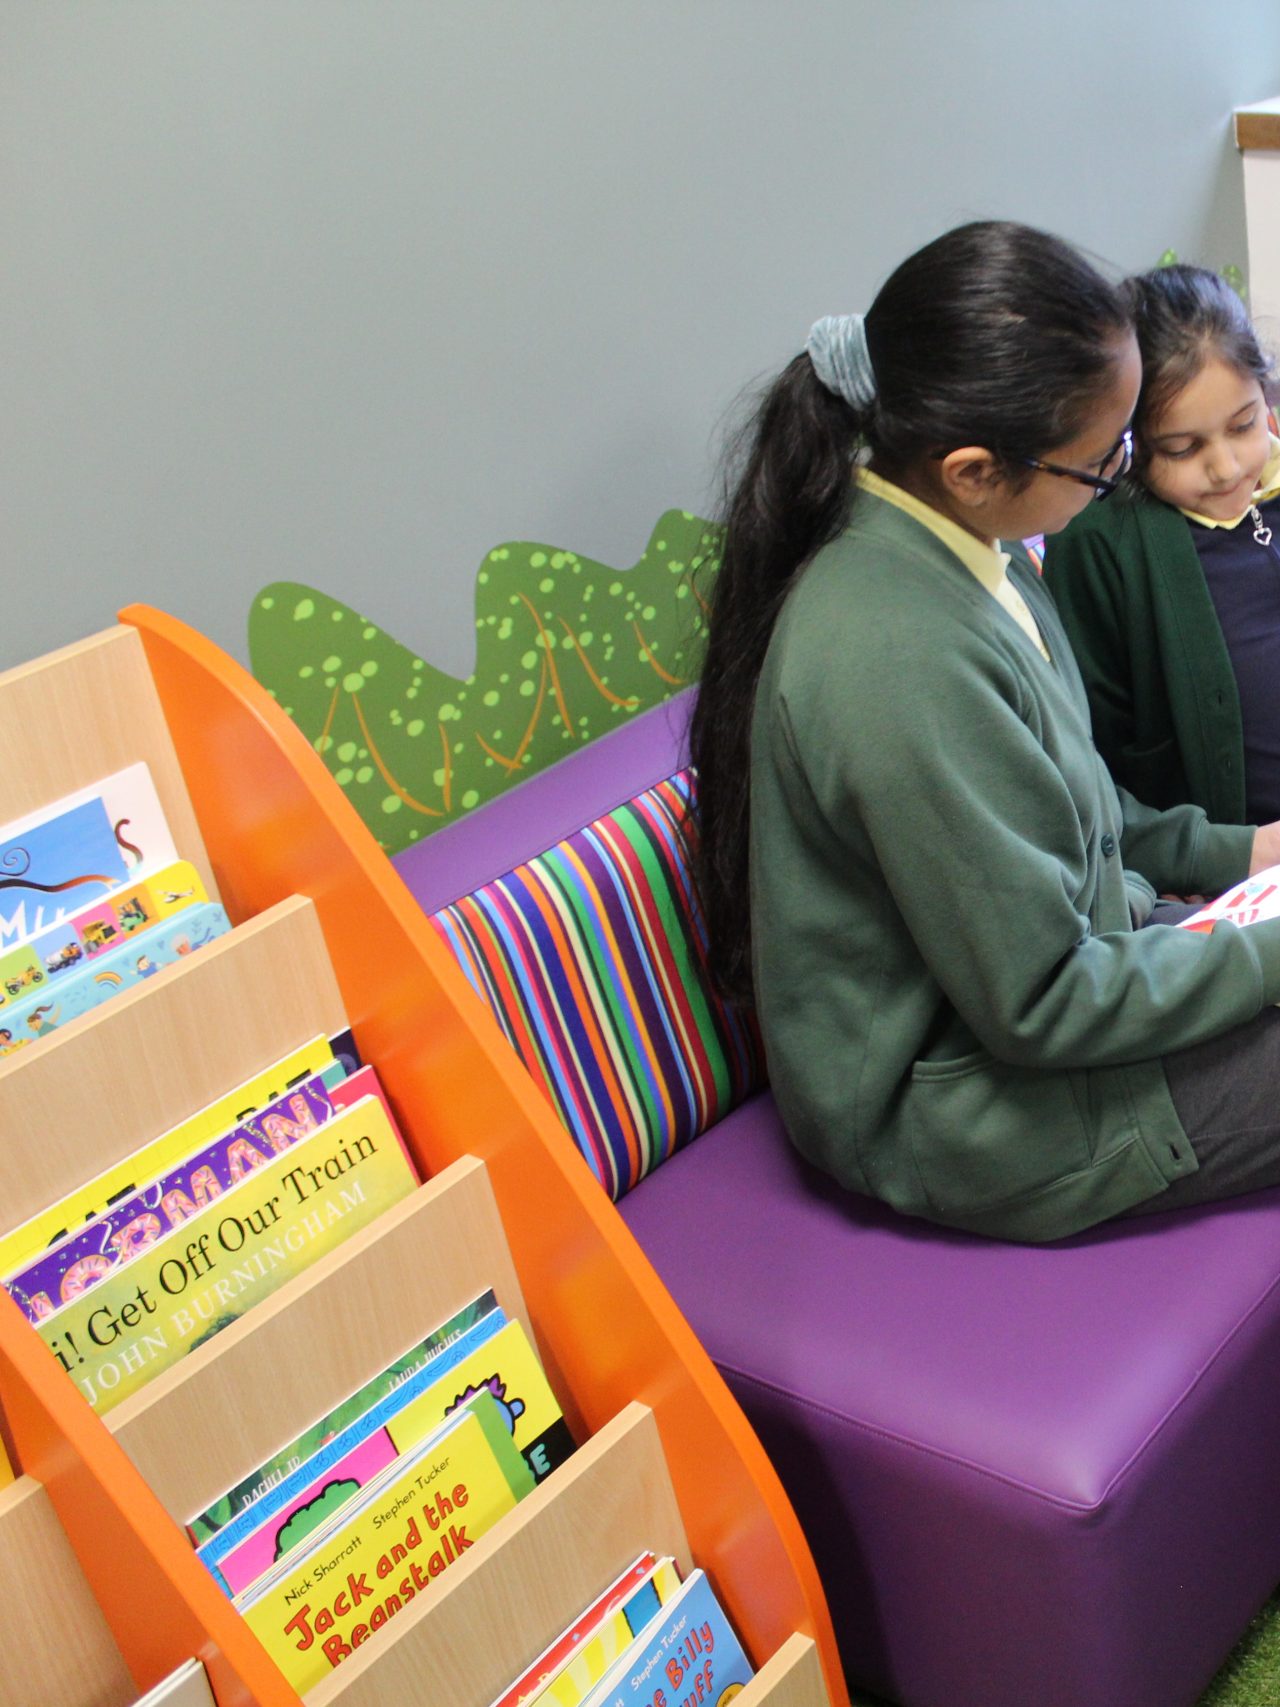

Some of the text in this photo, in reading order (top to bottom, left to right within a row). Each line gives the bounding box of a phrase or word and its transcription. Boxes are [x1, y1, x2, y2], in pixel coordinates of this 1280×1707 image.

[30, 1094, 318, 1321] ORMAN
[52, 1135, 378, 1373] i! Get Off Our Train
[80, 1326, 169, 1406] JOHN
[170, 1180, 367, 1338] BURNINGHAM
[283, 1483, 469, 1651] Jack and the
[284, 1457, 451, 1606] Nick Sharratt Stephen Tucker
[321, 1525, 474, 1669] Beanstalk
[631, 1649, 664, 1691] Stephen
[661, 1615, 687, 1648] Tucker
[665, 1621, 714, 1691] Billy
